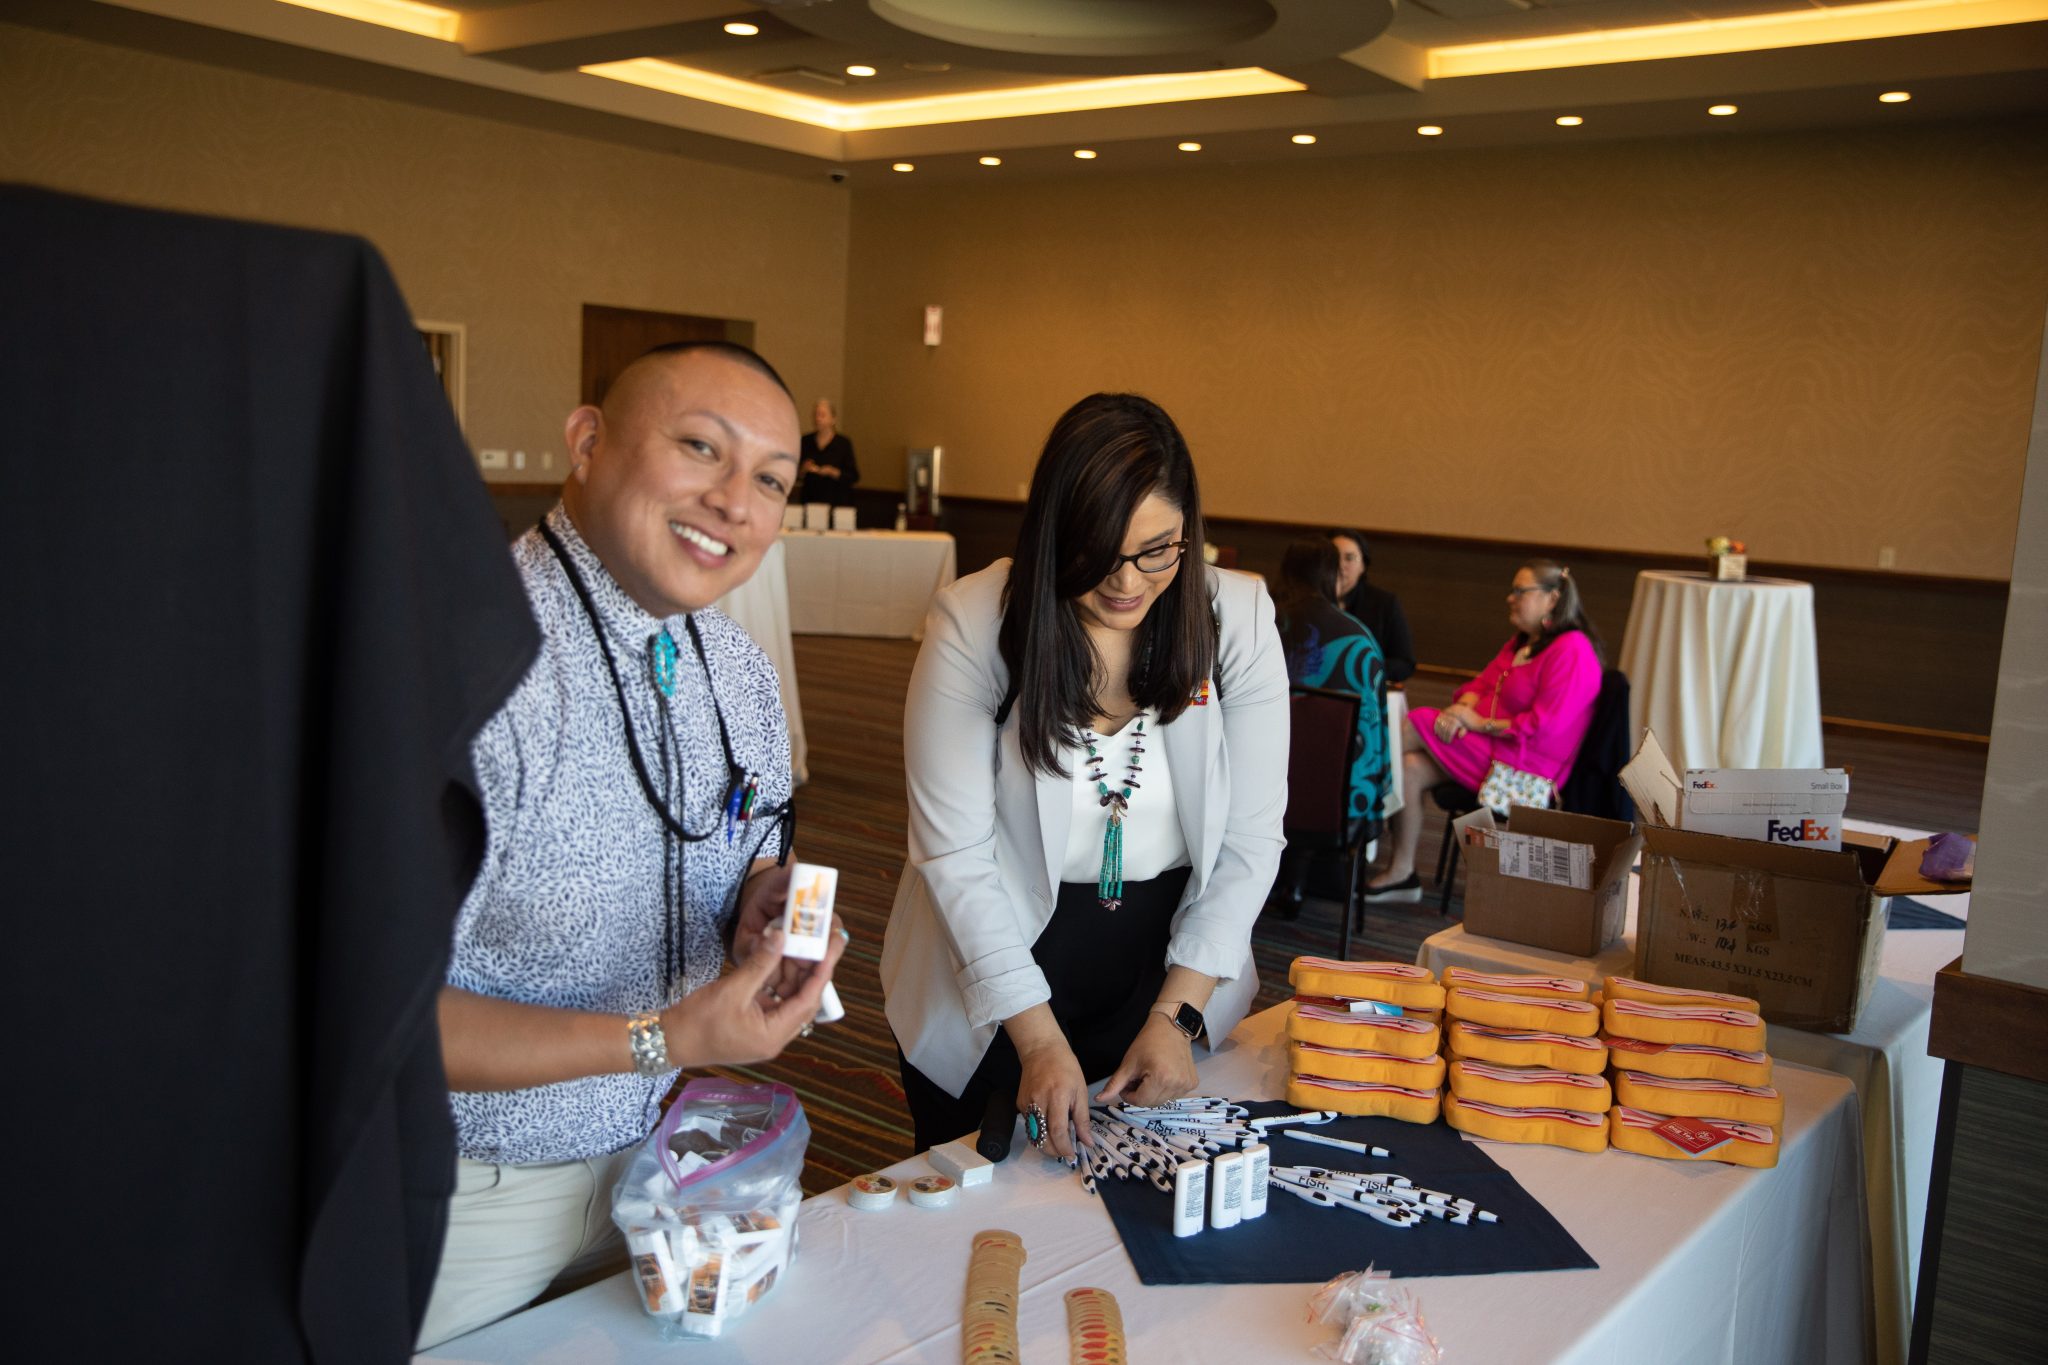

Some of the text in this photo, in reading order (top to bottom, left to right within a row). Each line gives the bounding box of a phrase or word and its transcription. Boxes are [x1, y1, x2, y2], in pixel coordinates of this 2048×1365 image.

[1693, 780, 1715, 789] FedEx
[1810, 782, 1843, 790] Small Box
[1767, 819, 1830, 842] FedEx
[1746, 943, 1771, 956] KGS
[1298, 1175, 1329, 1190] FISH.
[1360, 1178, 1393, 1193] FISH.
